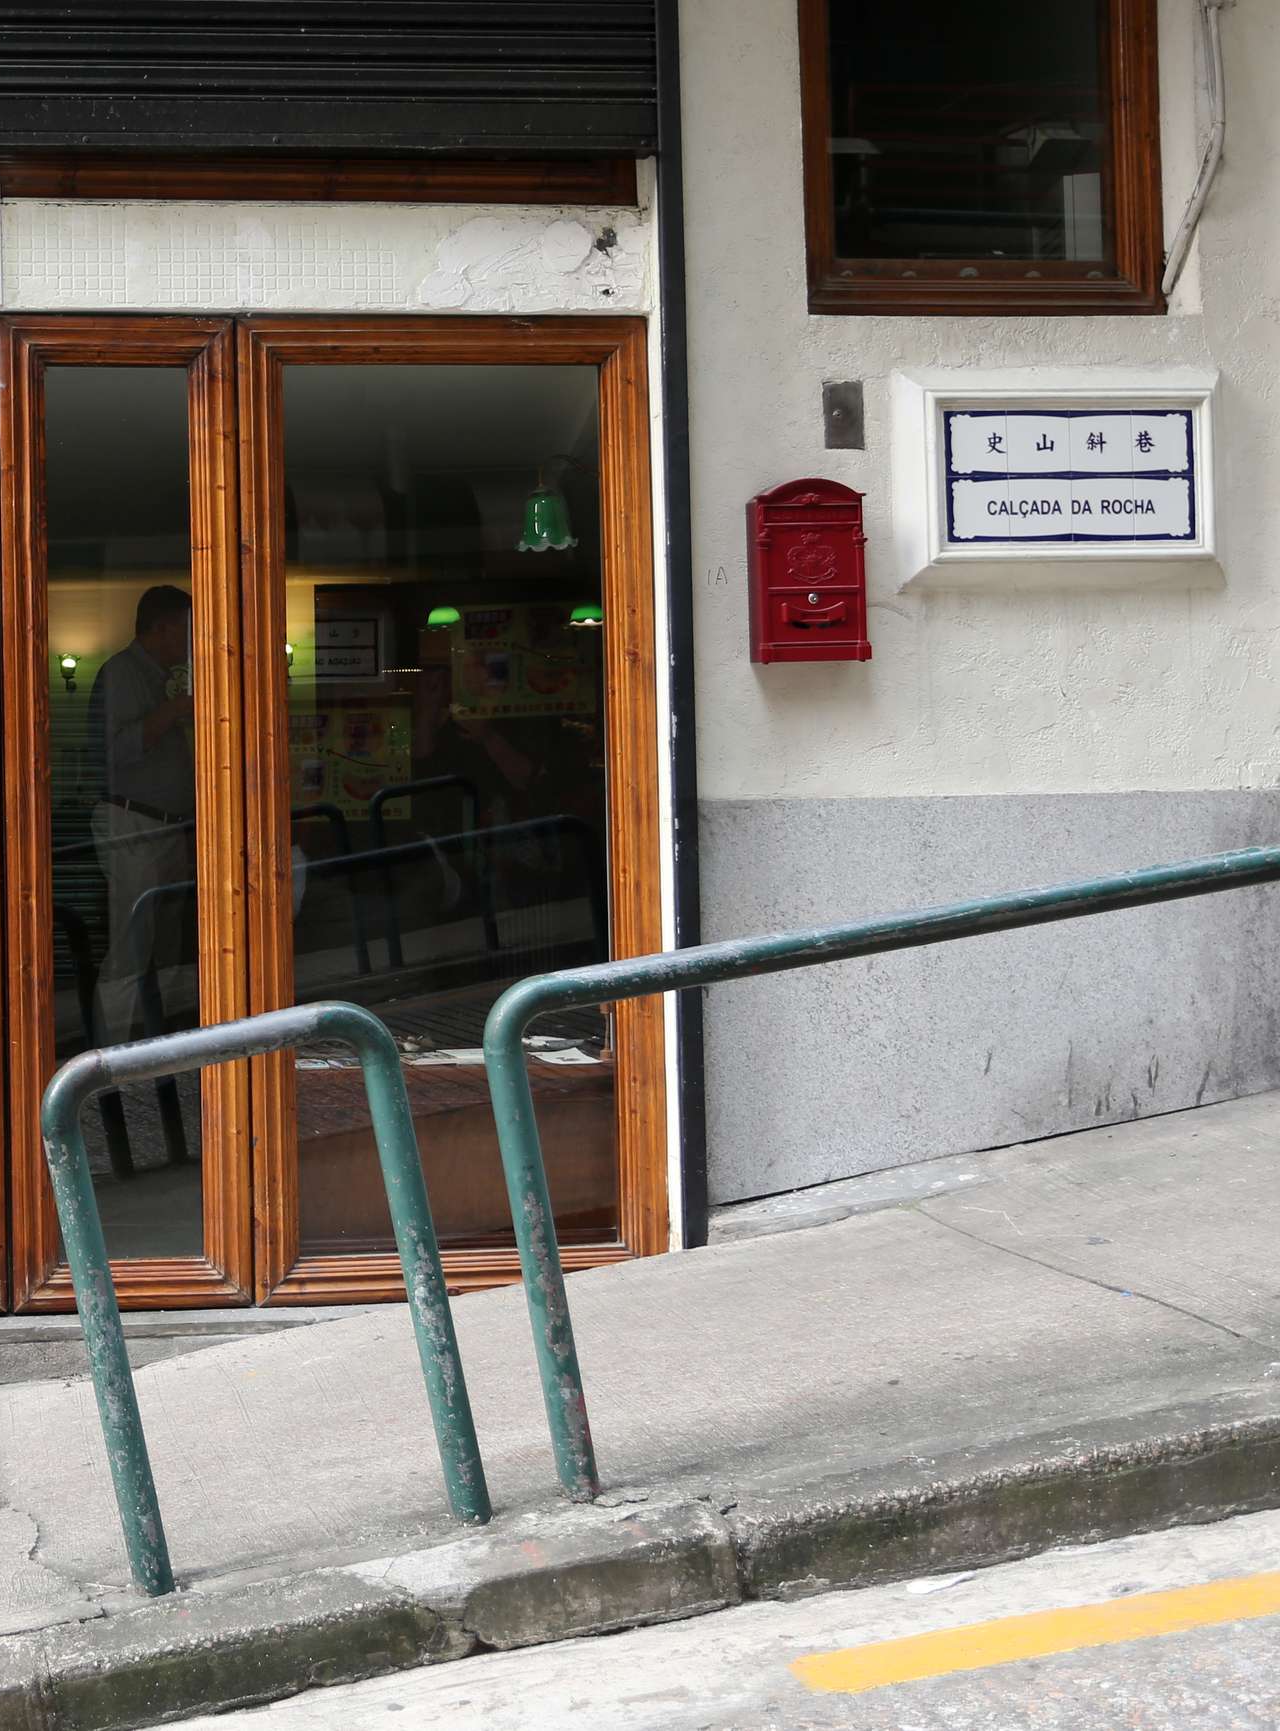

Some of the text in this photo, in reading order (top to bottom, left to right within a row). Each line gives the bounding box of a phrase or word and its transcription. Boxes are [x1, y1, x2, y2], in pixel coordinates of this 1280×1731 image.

[985, 431, 1155, 453] 史山斜巷
[987, 500, 1155, 518] CALÇADA DA ROCHA
